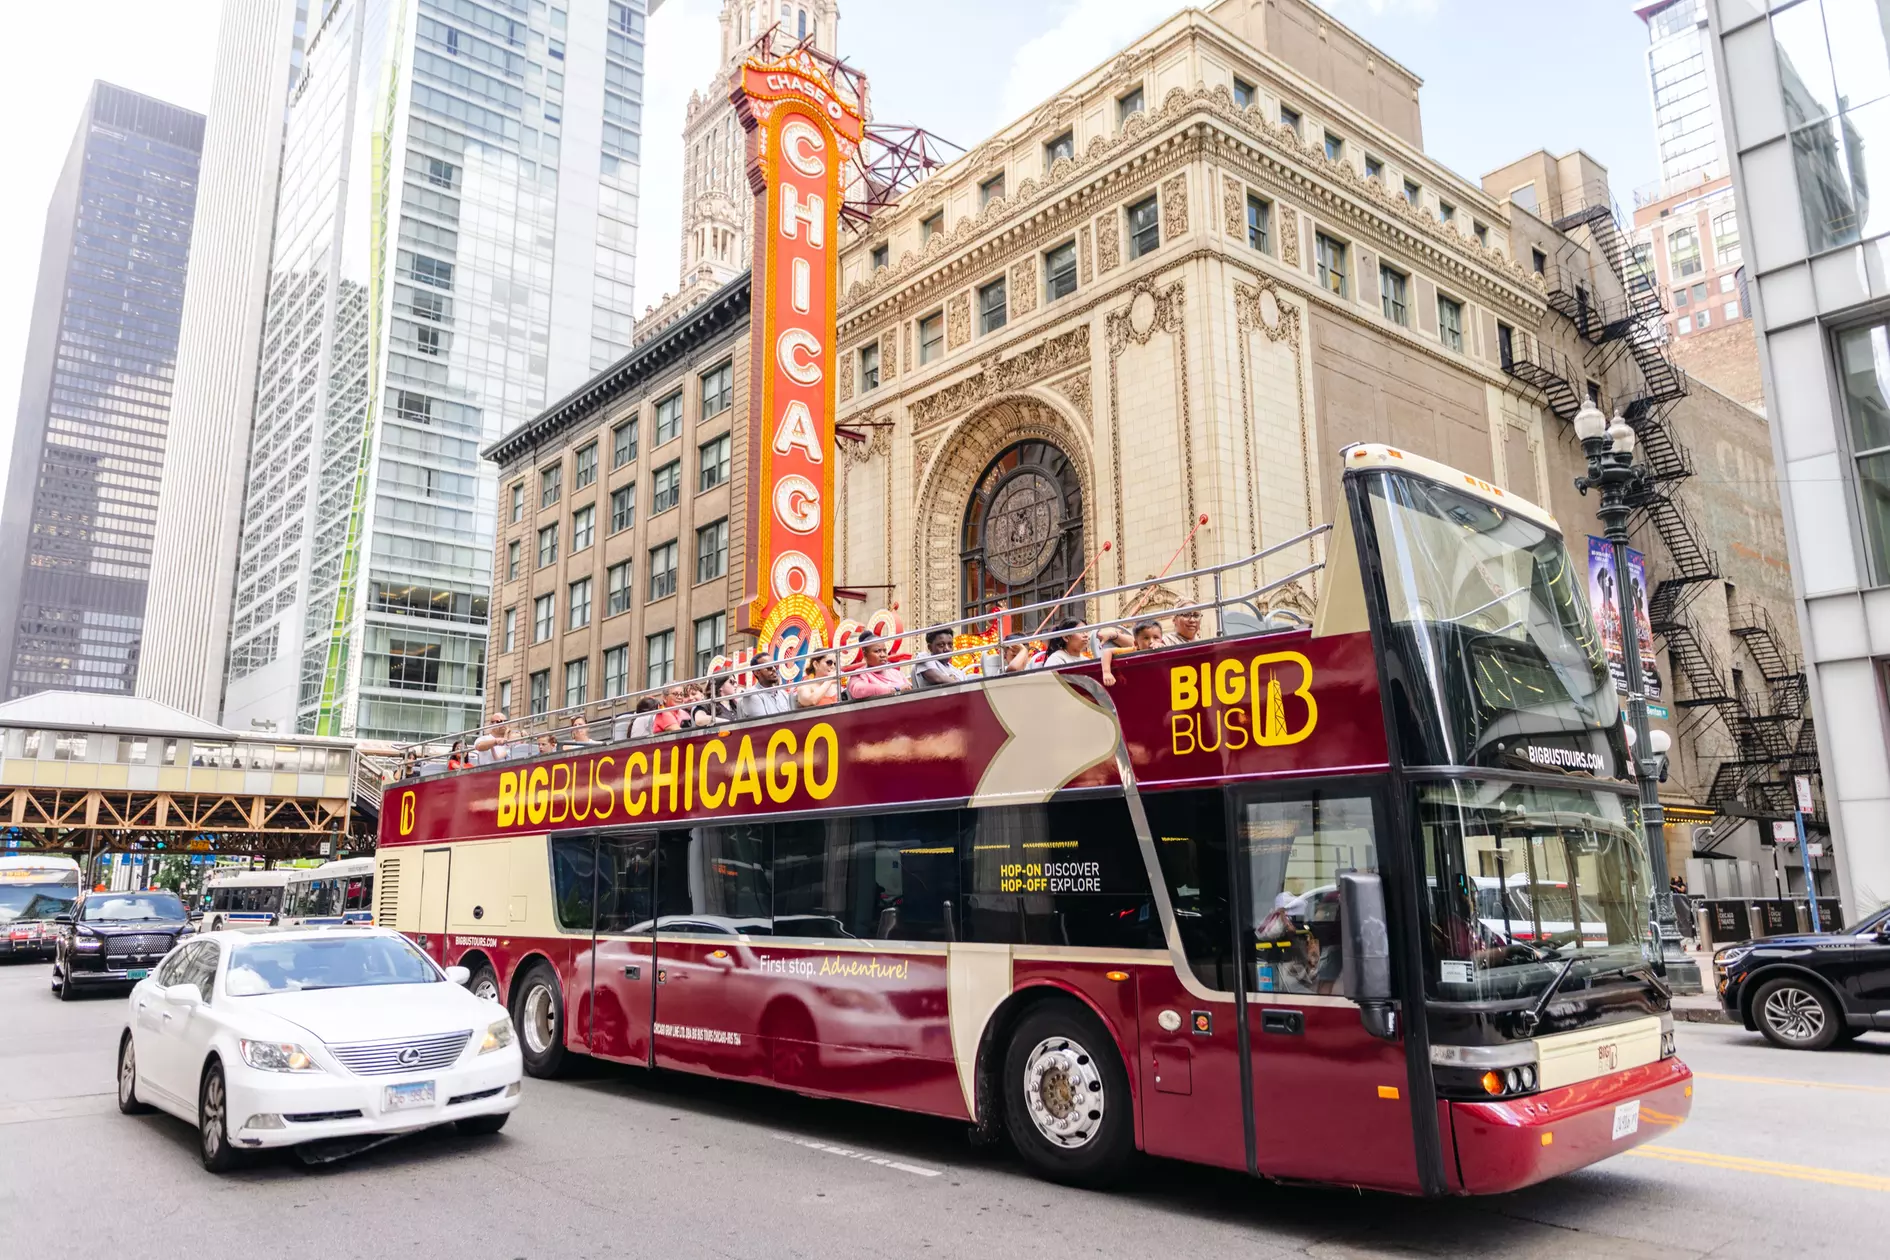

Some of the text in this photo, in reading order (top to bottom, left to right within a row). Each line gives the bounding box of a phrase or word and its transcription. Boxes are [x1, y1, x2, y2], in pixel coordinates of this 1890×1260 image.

[766, 74, 827, 105] CHASE
[772, 120, 826, 600] CHICAGO
[1170, 658, 1246, 711] BIG
[1171, 707, 1249, 755] BUS
[623, 722, 839, 817] CHICAGO
[1528, 745, 1605, 770] BIGBUSTOURS.COM
[1000, 862, 1100, 877] HOP-ON DISCOVER
[1001, 877, 1101, 892] HOP-OFF EXPLORE
[455, 936, 498, 948] BIGBUSTOURS.COM
[760, 955, 909, 980] First stop. Adventure!
